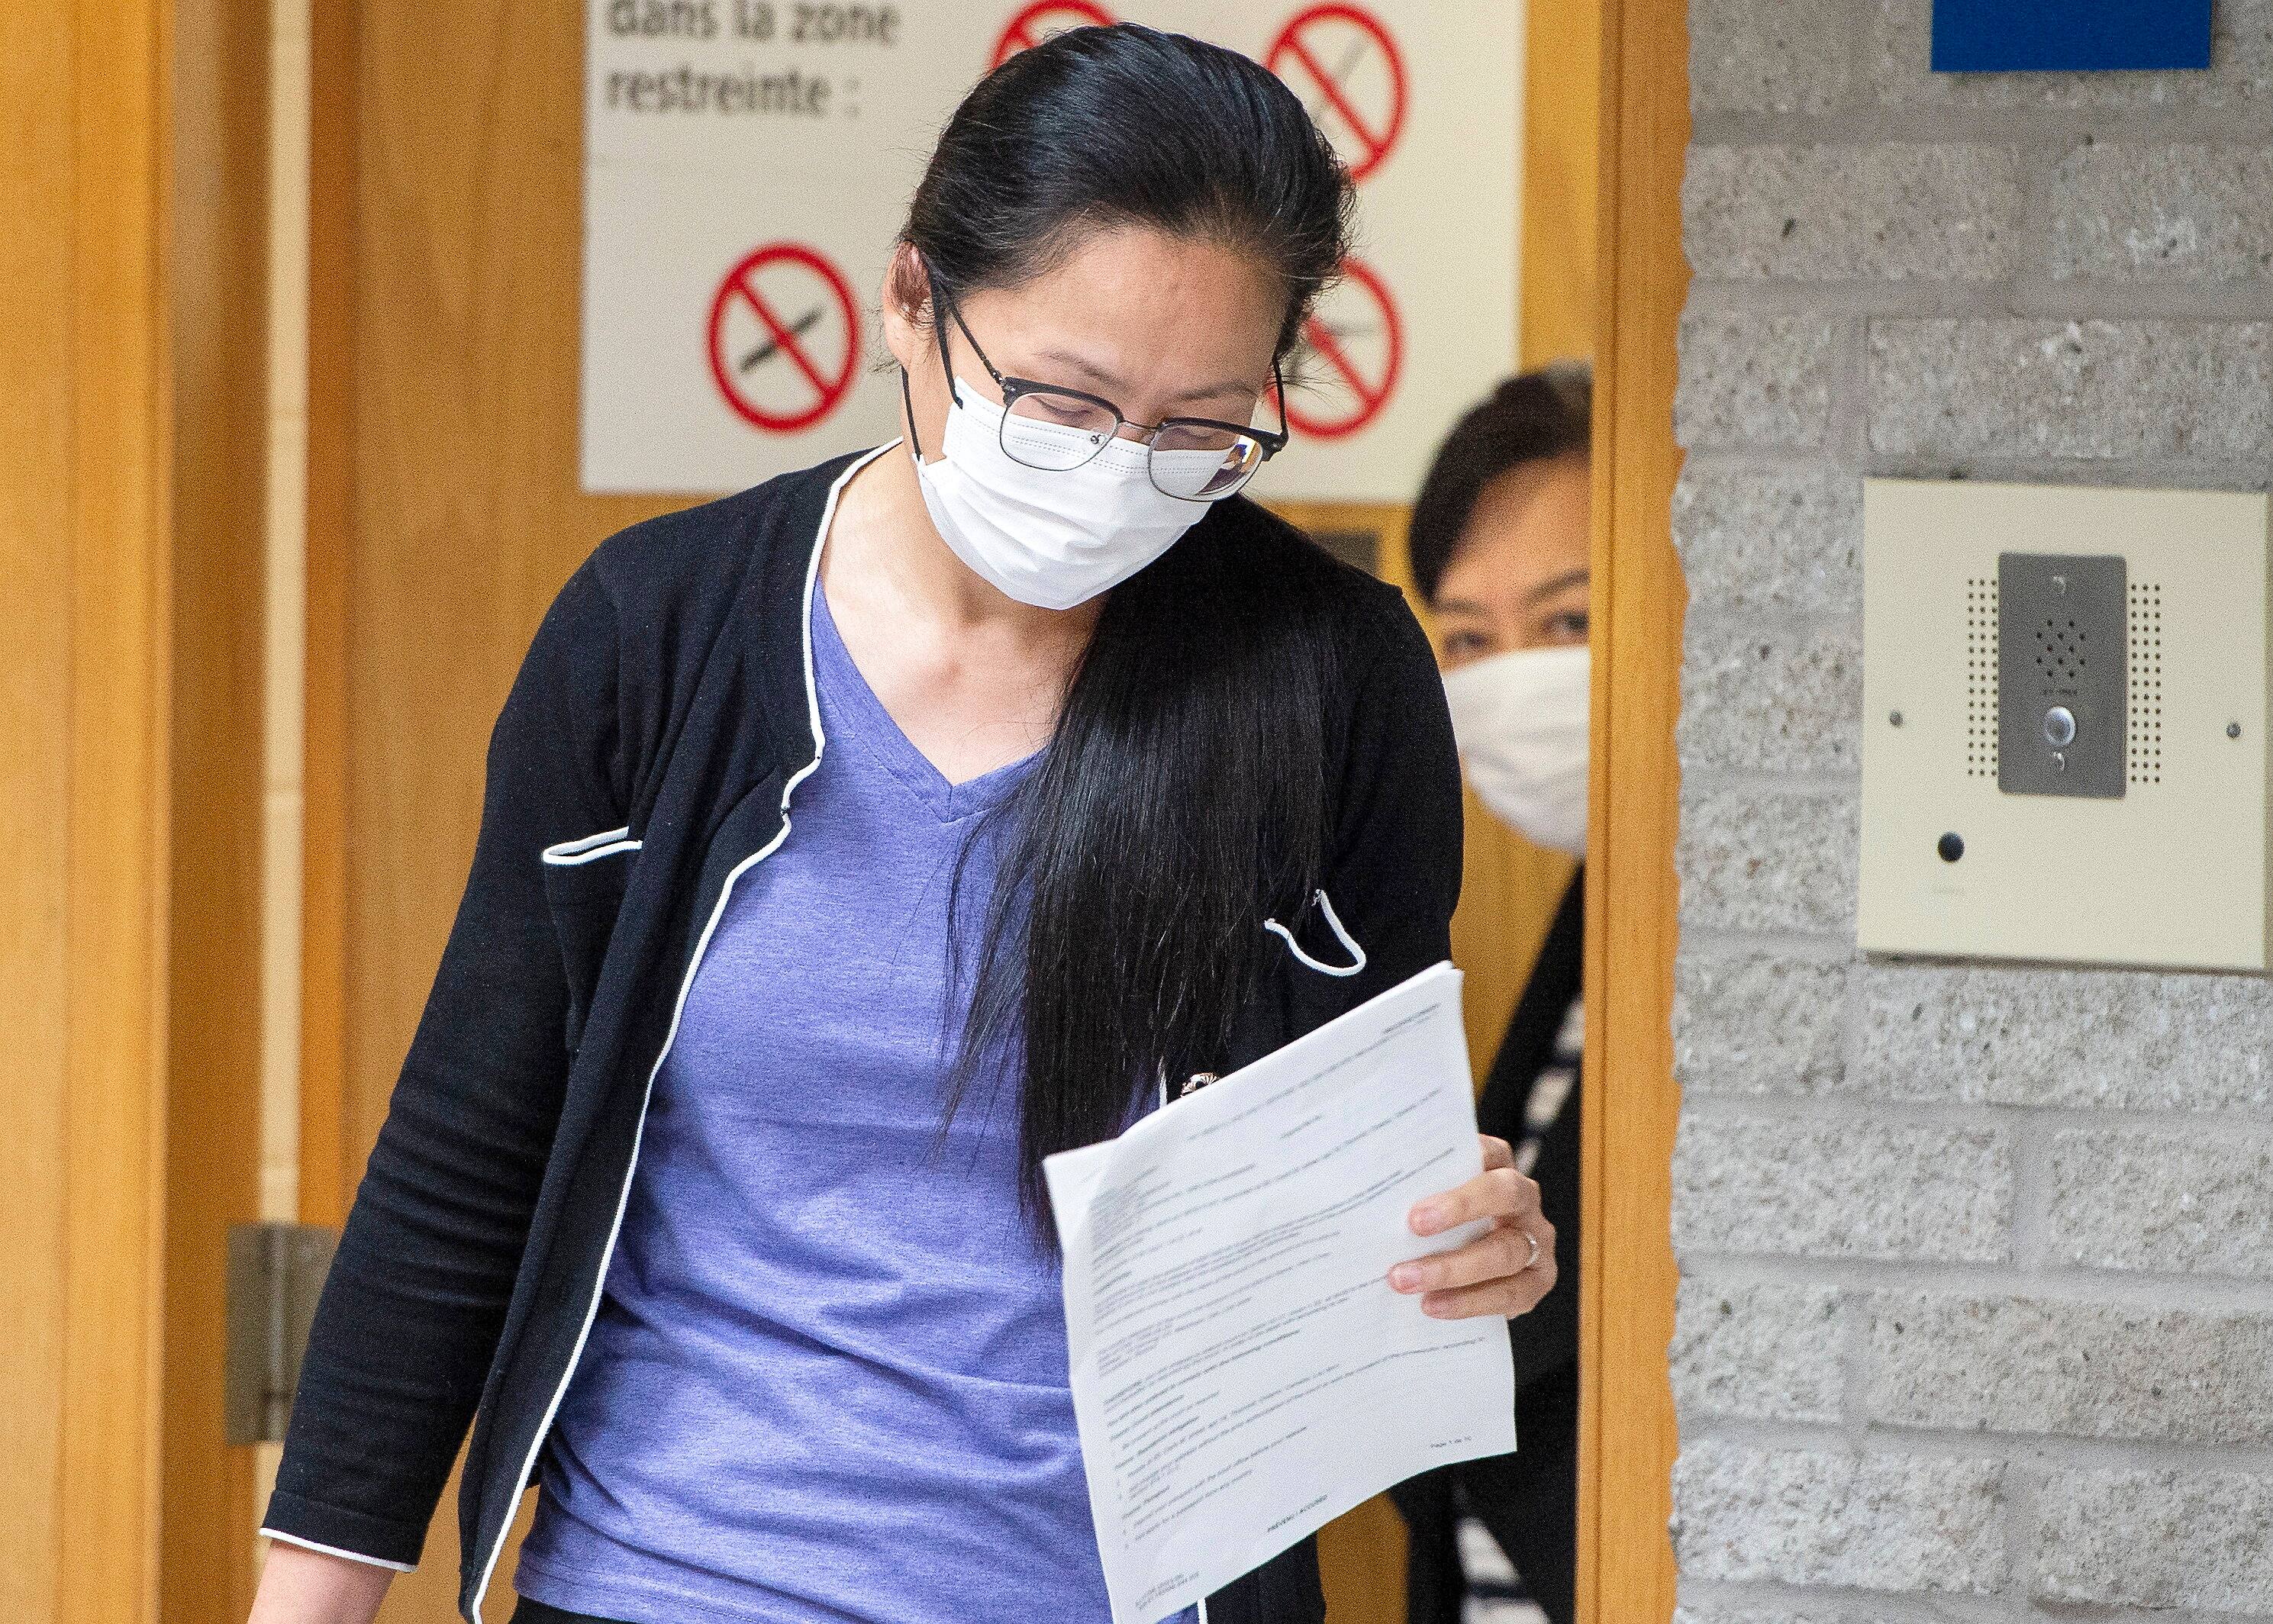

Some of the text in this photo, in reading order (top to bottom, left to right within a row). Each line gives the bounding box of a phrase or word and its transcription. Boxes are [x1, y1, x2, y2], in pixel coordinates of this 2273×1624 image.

[605, 0, 900, 44] dans la zone
[606, 61, 830, 116] restreinte
